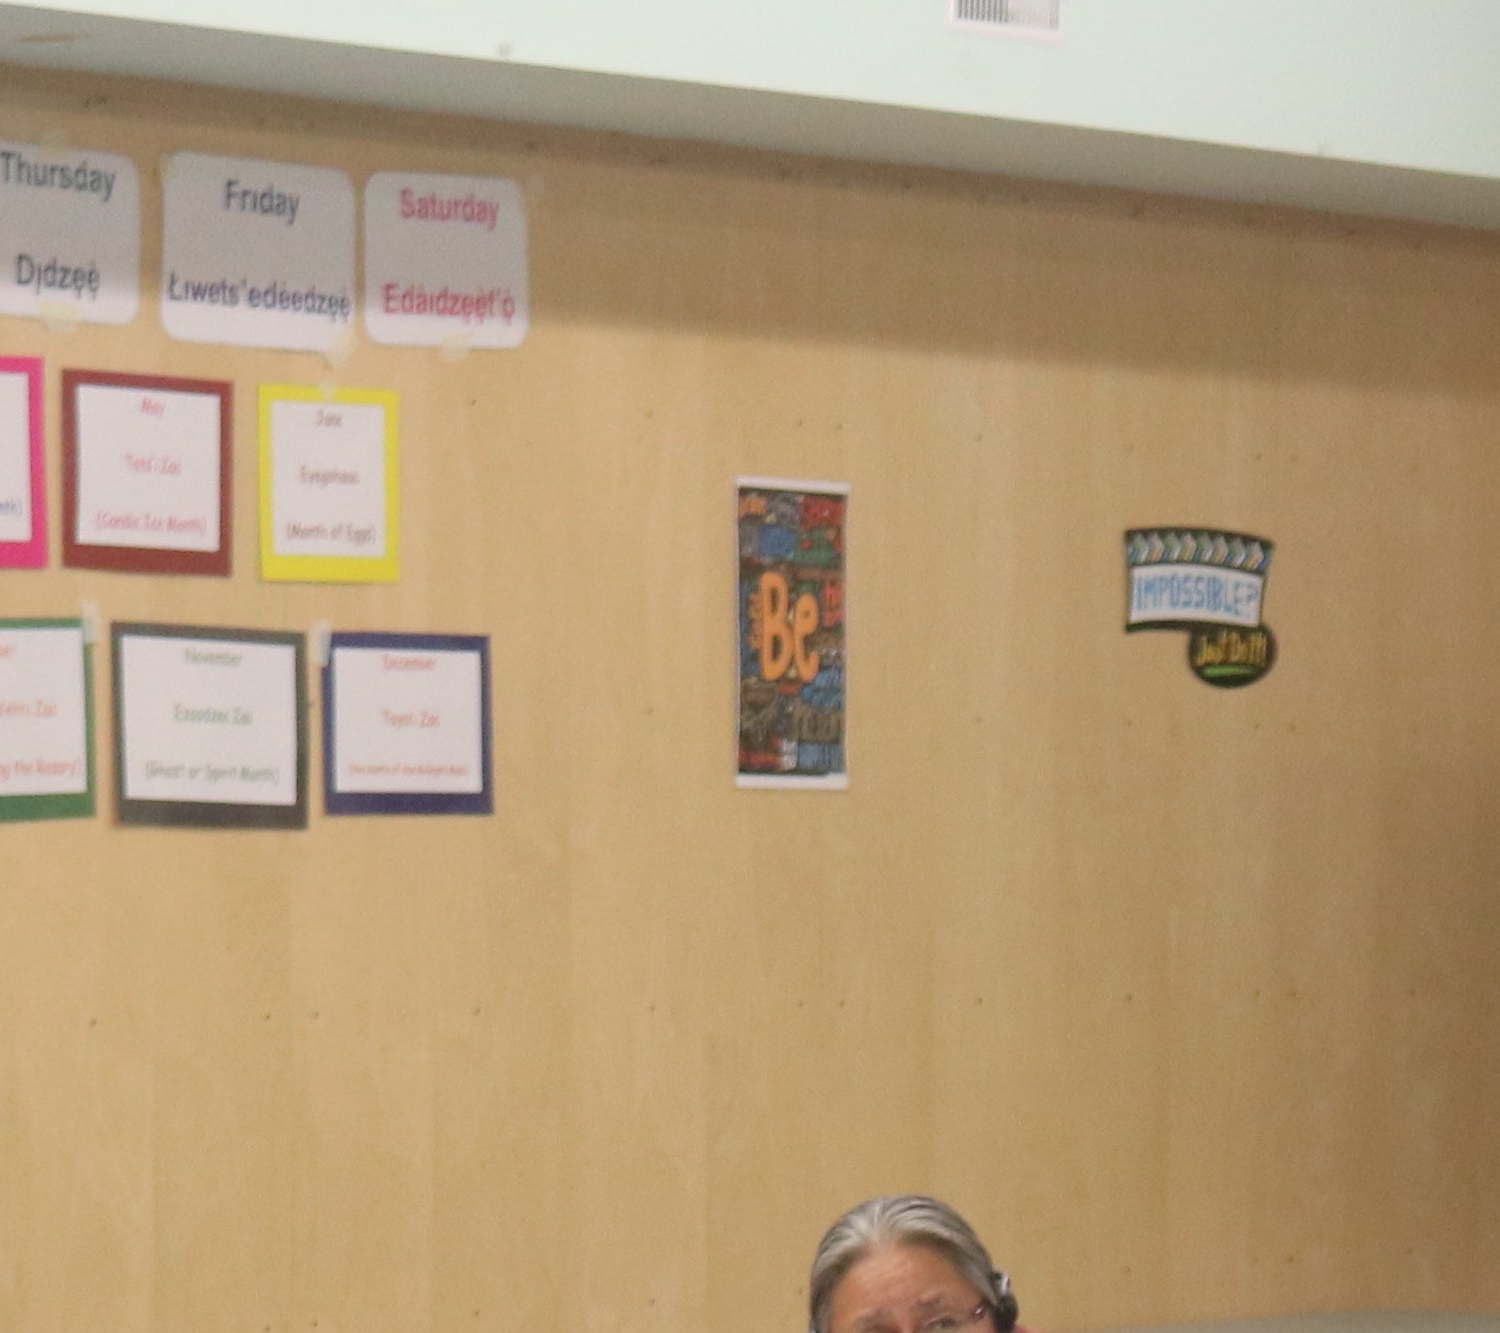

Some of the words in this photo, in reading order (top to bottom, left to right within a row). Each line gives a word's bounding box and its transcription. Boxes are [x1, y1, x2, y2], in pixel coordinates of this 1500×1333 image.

[0, 150, 118, 201] Thursday
[223, 178, 301, 226] Friday
[399, 187, 500, 231] Saturday
[759, 571, 820, 682] Be
